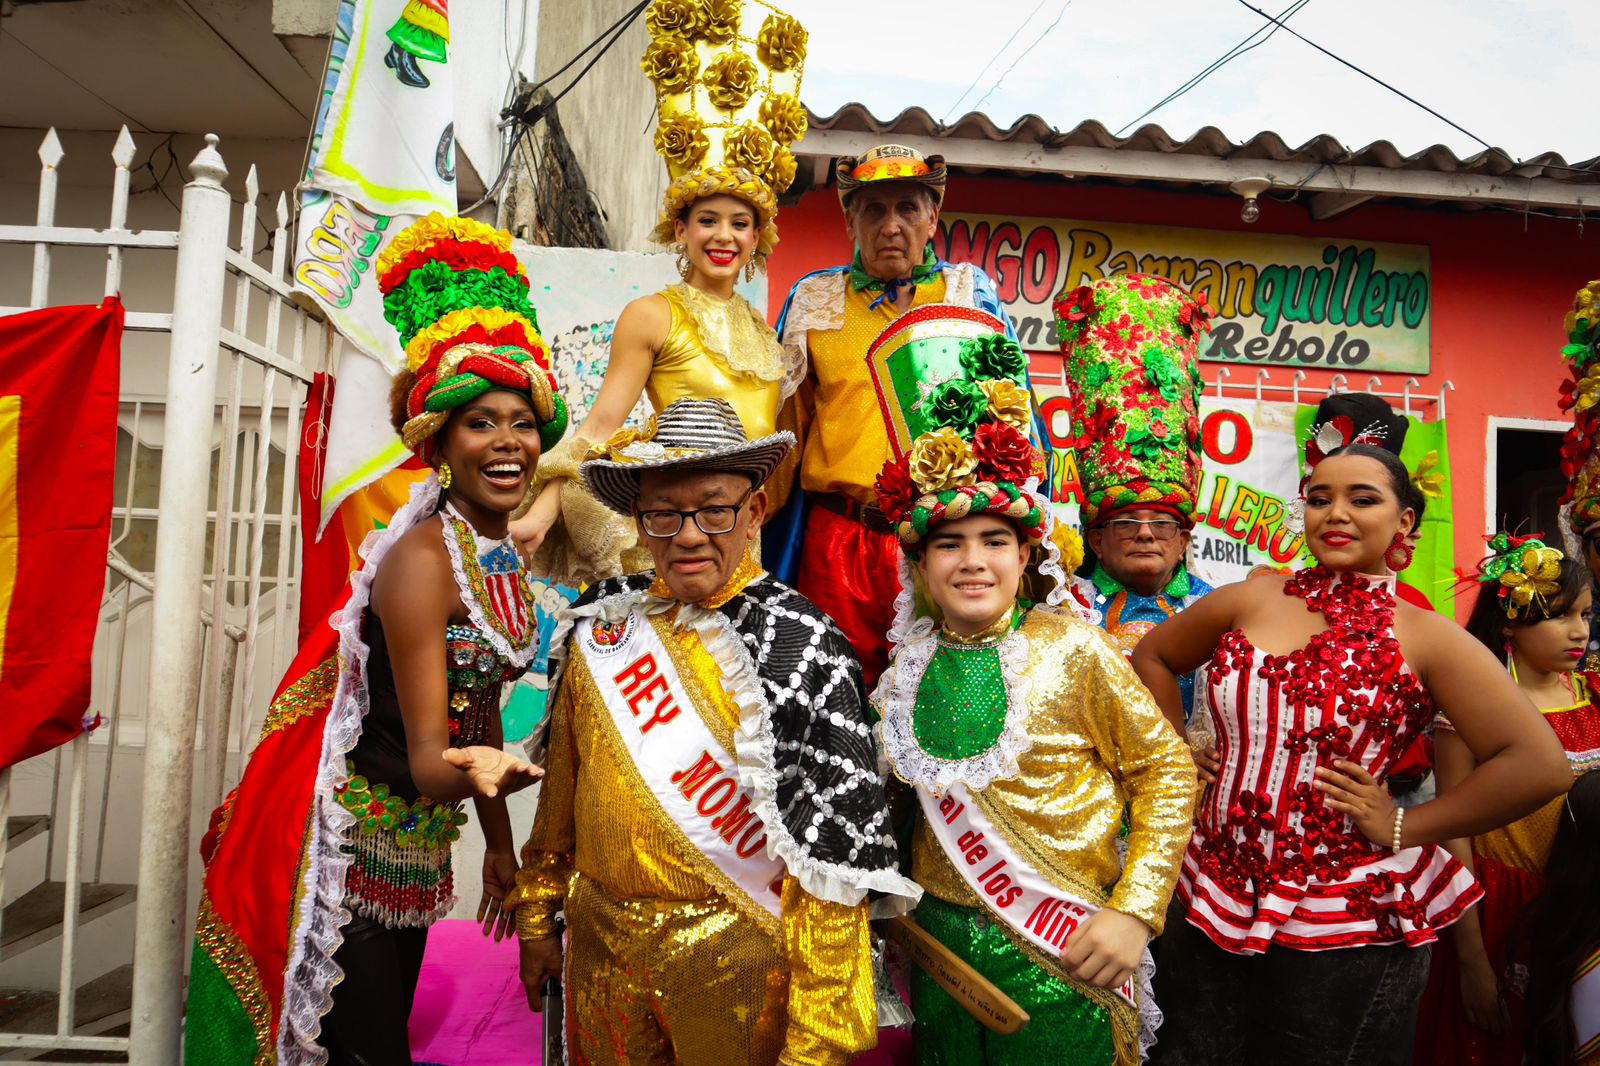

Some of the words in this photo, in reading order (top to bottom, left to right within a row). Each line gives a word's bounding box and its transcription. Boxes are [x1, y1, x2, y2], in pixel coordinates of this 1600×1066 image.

[1205, 322, 1370, 366] Rebolo
[1201, 537, 1253, 566] ABRIL
[613, 652, 682, 735] REY
[670, 749, 768, 859] MOMO
[957, 830, 989, 866] de
[977, 859, 1024, 908] los
